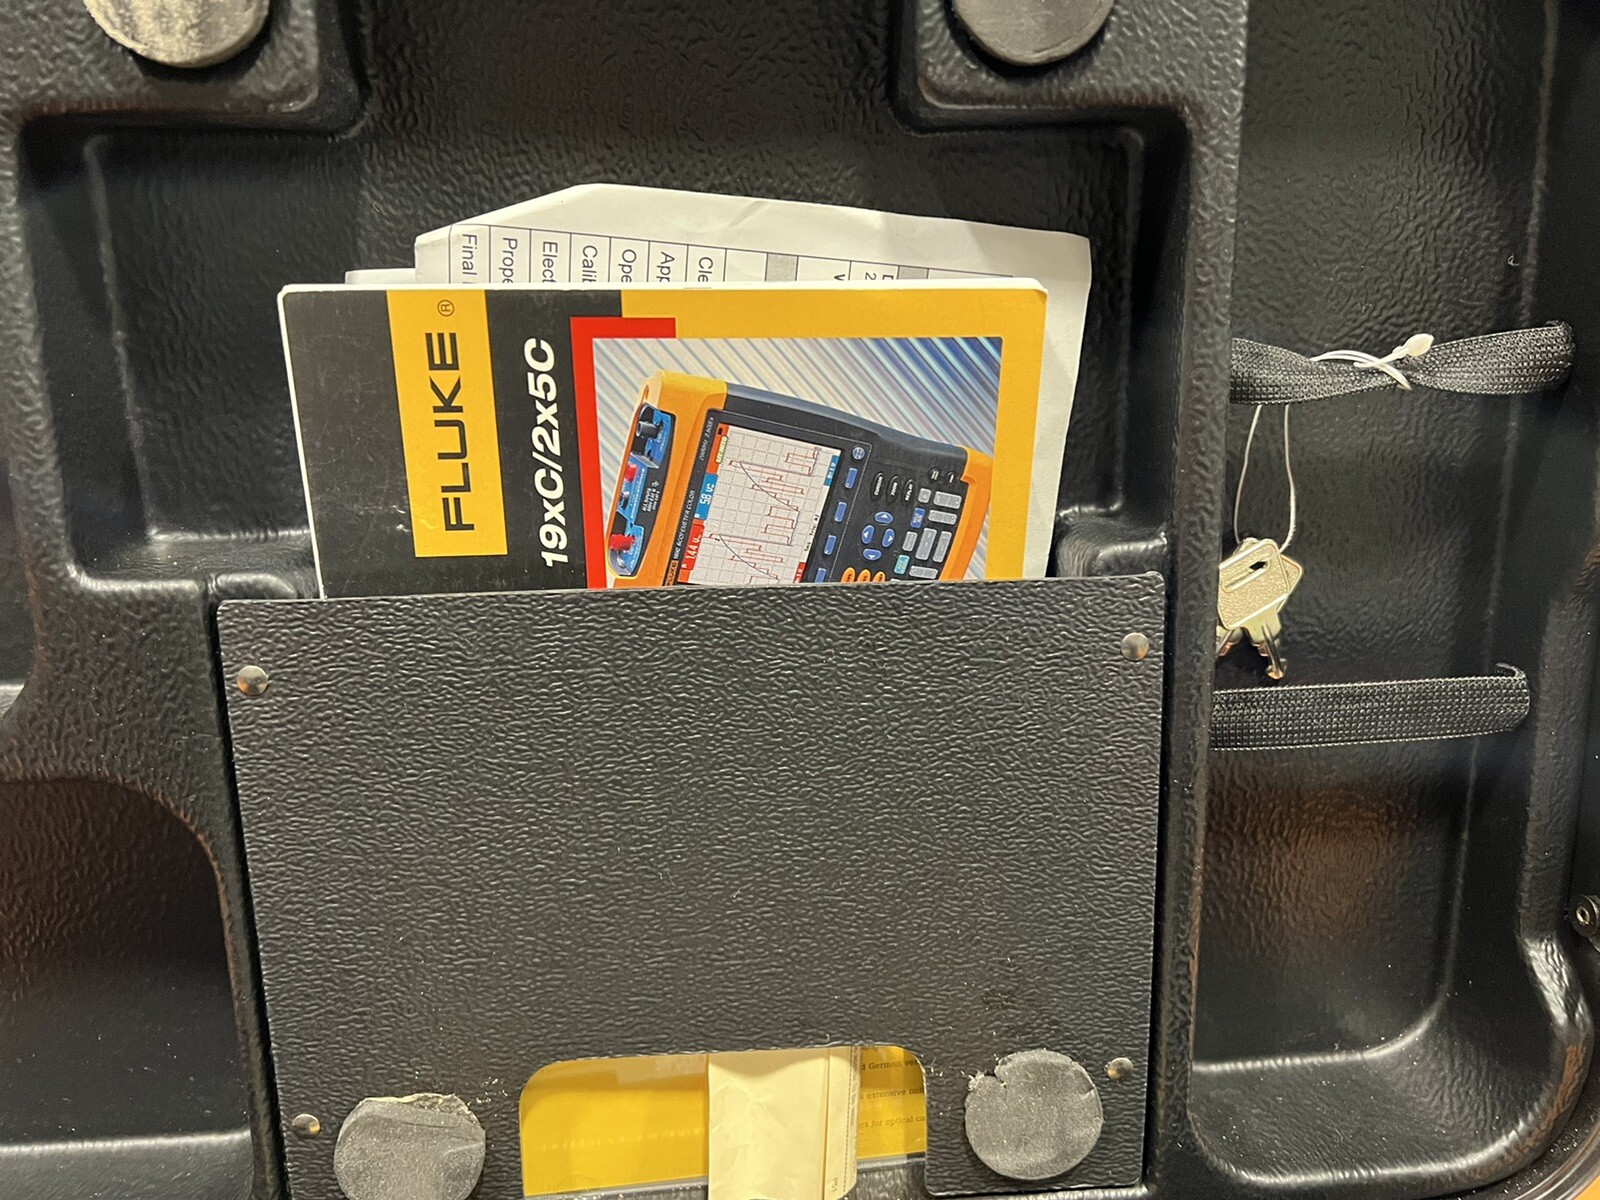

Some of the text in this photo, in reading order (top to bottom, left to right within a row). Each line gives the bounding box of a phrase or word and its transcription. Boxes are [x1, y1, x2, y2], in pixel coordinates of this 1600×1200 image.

[461, 233, 478, 276] Final
[542, 241, 558, 283] Elect
[618, 248, 637, 282] Ope
[697, 256, 714, 282] Cle
[425, 331, 475, 532] FLUKE
[524, 337, 568, 568] 19xC/2x5C
